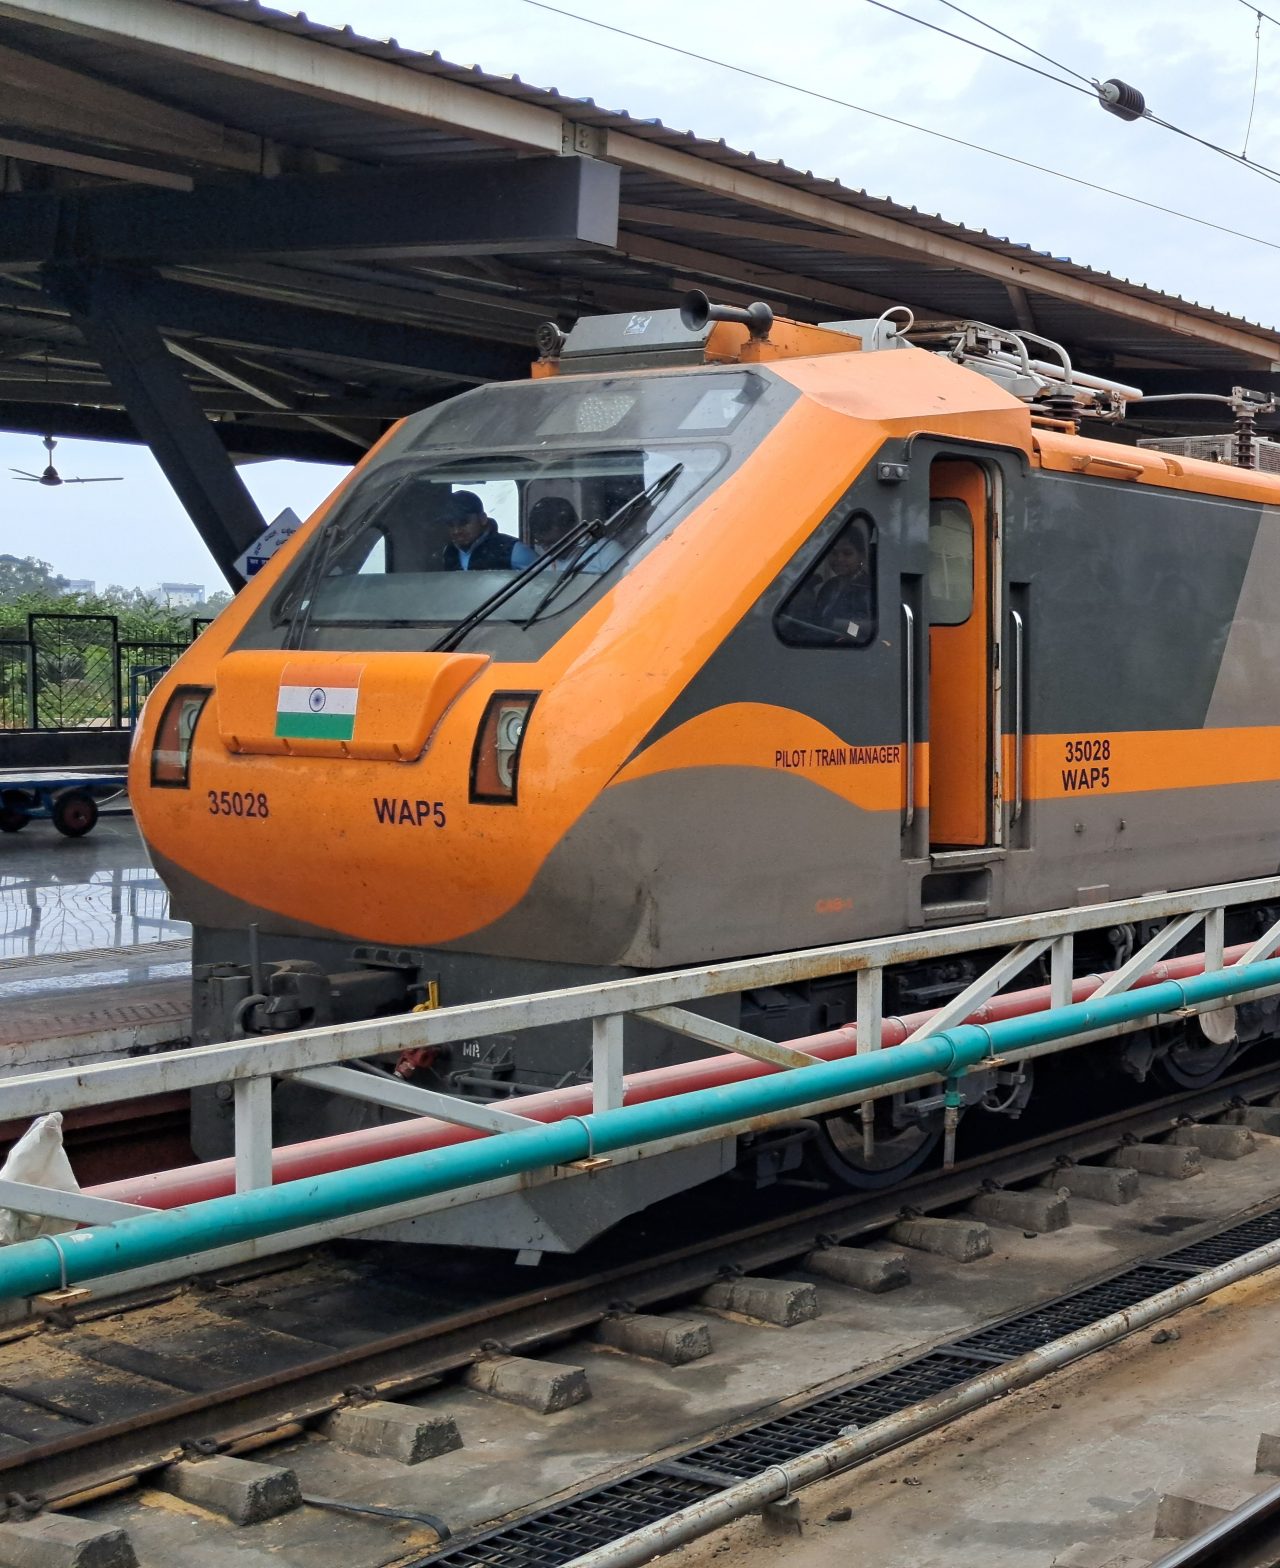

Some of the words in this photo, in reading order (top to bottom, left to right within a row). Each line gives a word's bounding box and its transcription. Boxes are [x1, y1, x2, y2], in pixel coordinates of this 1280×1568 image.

[775, 749, 807, 768] PILOT
[815, 748, 847, 767] TRAIN
[849, 746, 901, 765] MANAGER
[1065, 739, 1111, 763] 35028
[1061, 767, 1110, 791] WAP5
[207, 790, 270, 819] 35028
[372, 797, 447, 829] WAP5
